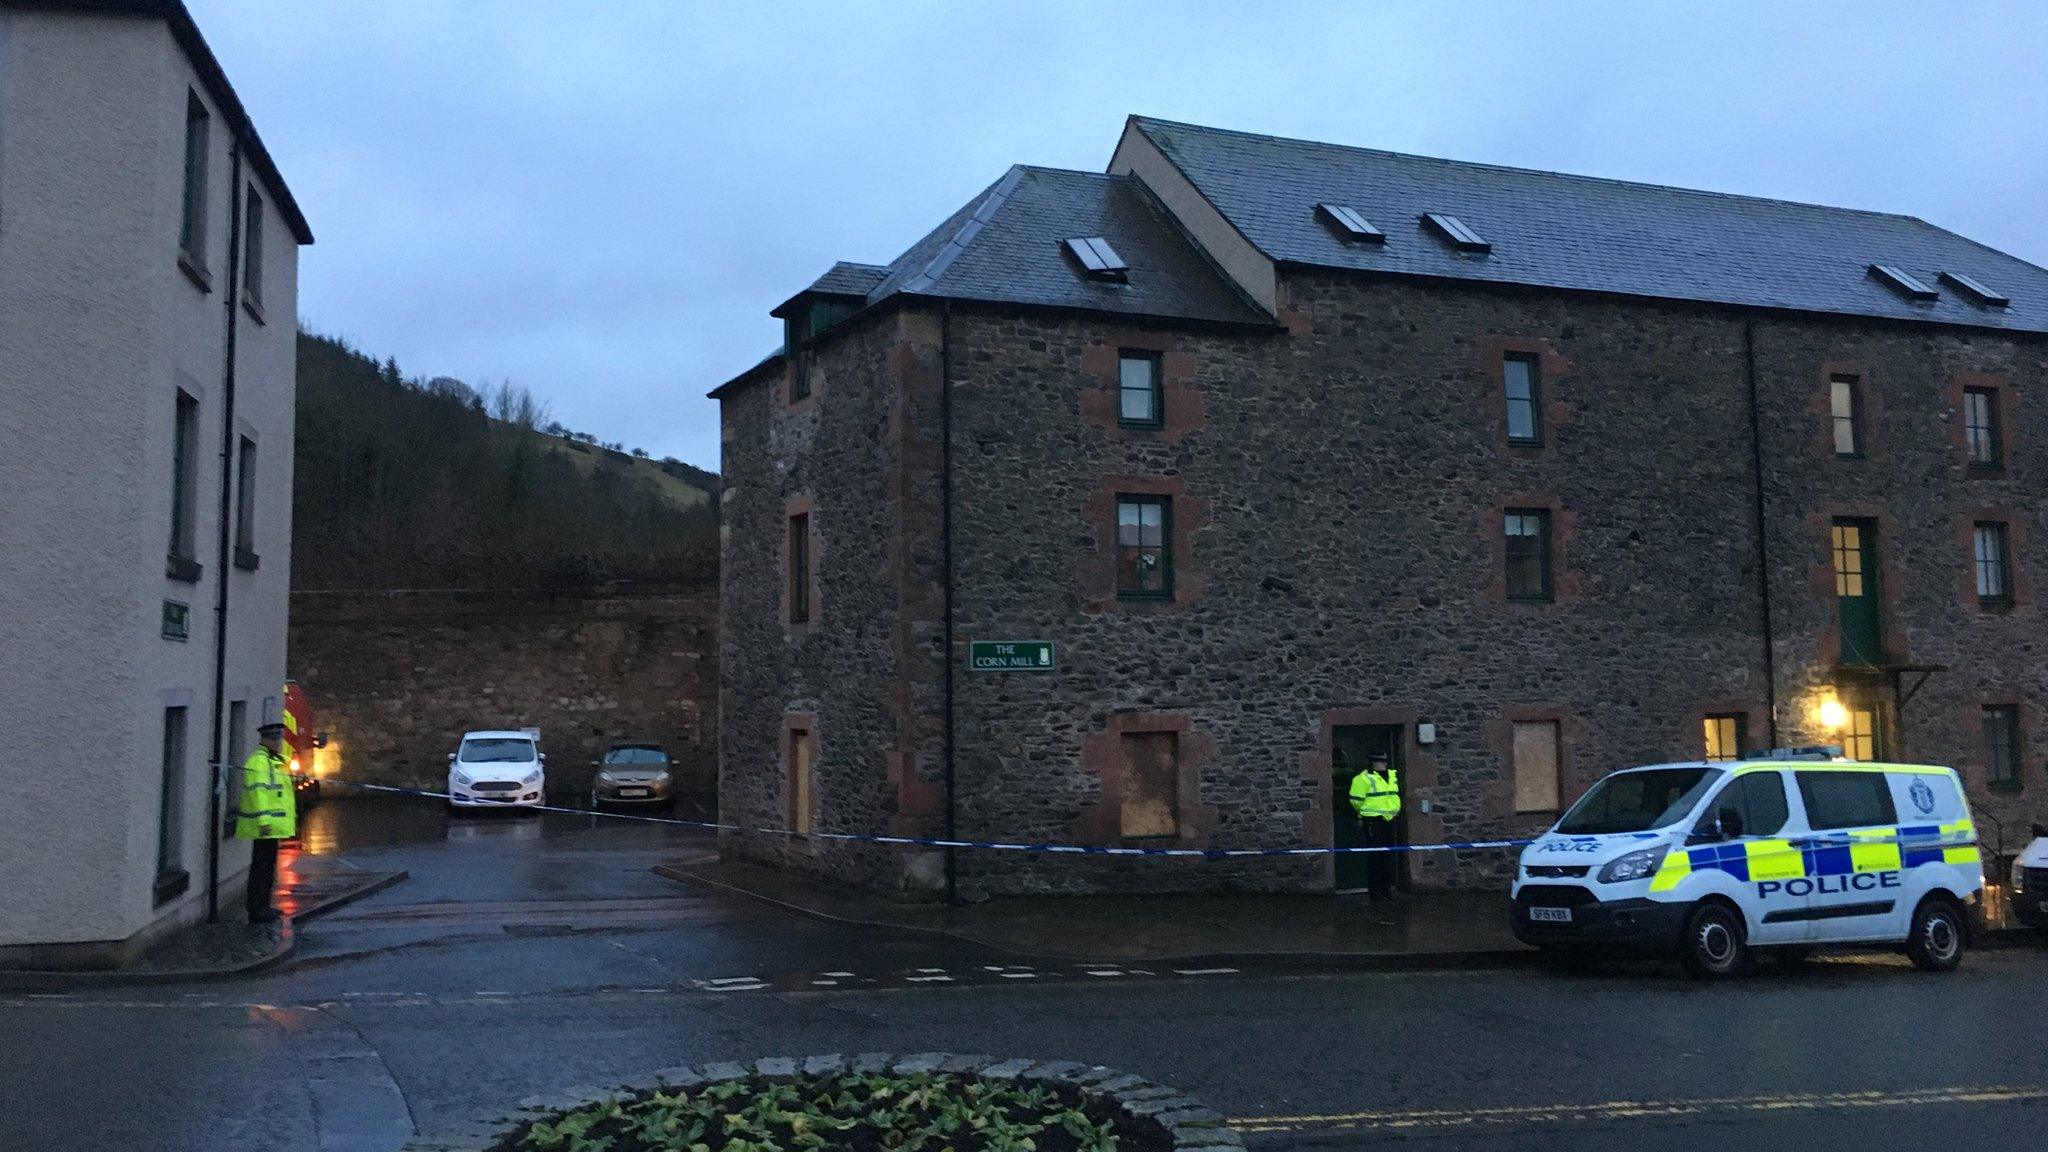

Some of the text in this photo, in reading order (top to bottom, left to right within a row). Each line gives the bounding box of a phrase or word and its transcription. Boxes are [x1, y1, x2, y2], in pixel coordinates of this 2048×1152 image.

[996, 645, 1015, 654] THE
[976, 657, 1034, 667] CORN MILL
[1538, 842, 1602, 853] POLICE
[1757, 871, 1901, 898] POLICE
